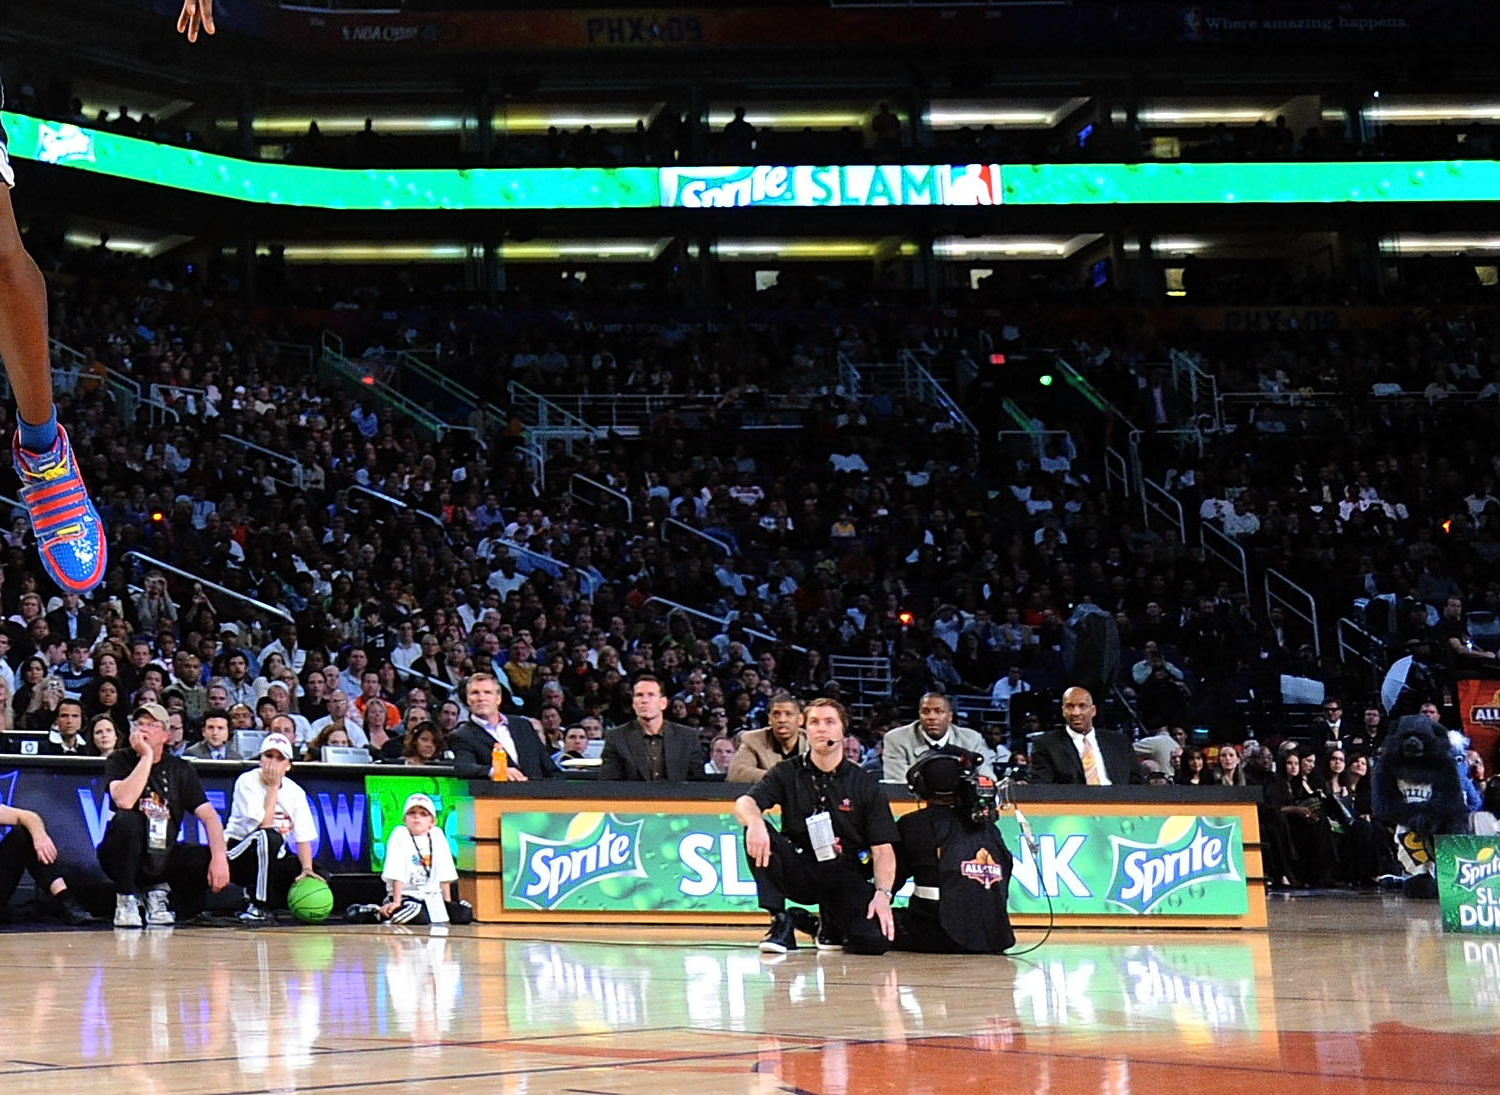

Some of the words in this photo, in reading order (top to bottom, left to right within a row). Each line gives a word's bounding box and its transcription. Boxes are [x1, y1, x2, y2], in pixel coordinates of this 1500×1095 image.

[1207, 15, 1258, 31] Where
[1262, 16, 1332, 33] amazing
[812, 166, 939, 205] SLAM
[525, 822, 631, 900] Sprite
[677, 832, 758, 897] SL
[1011, 834, 1094, 898] NK
[1120, 824, 1224, 903] Sprite
